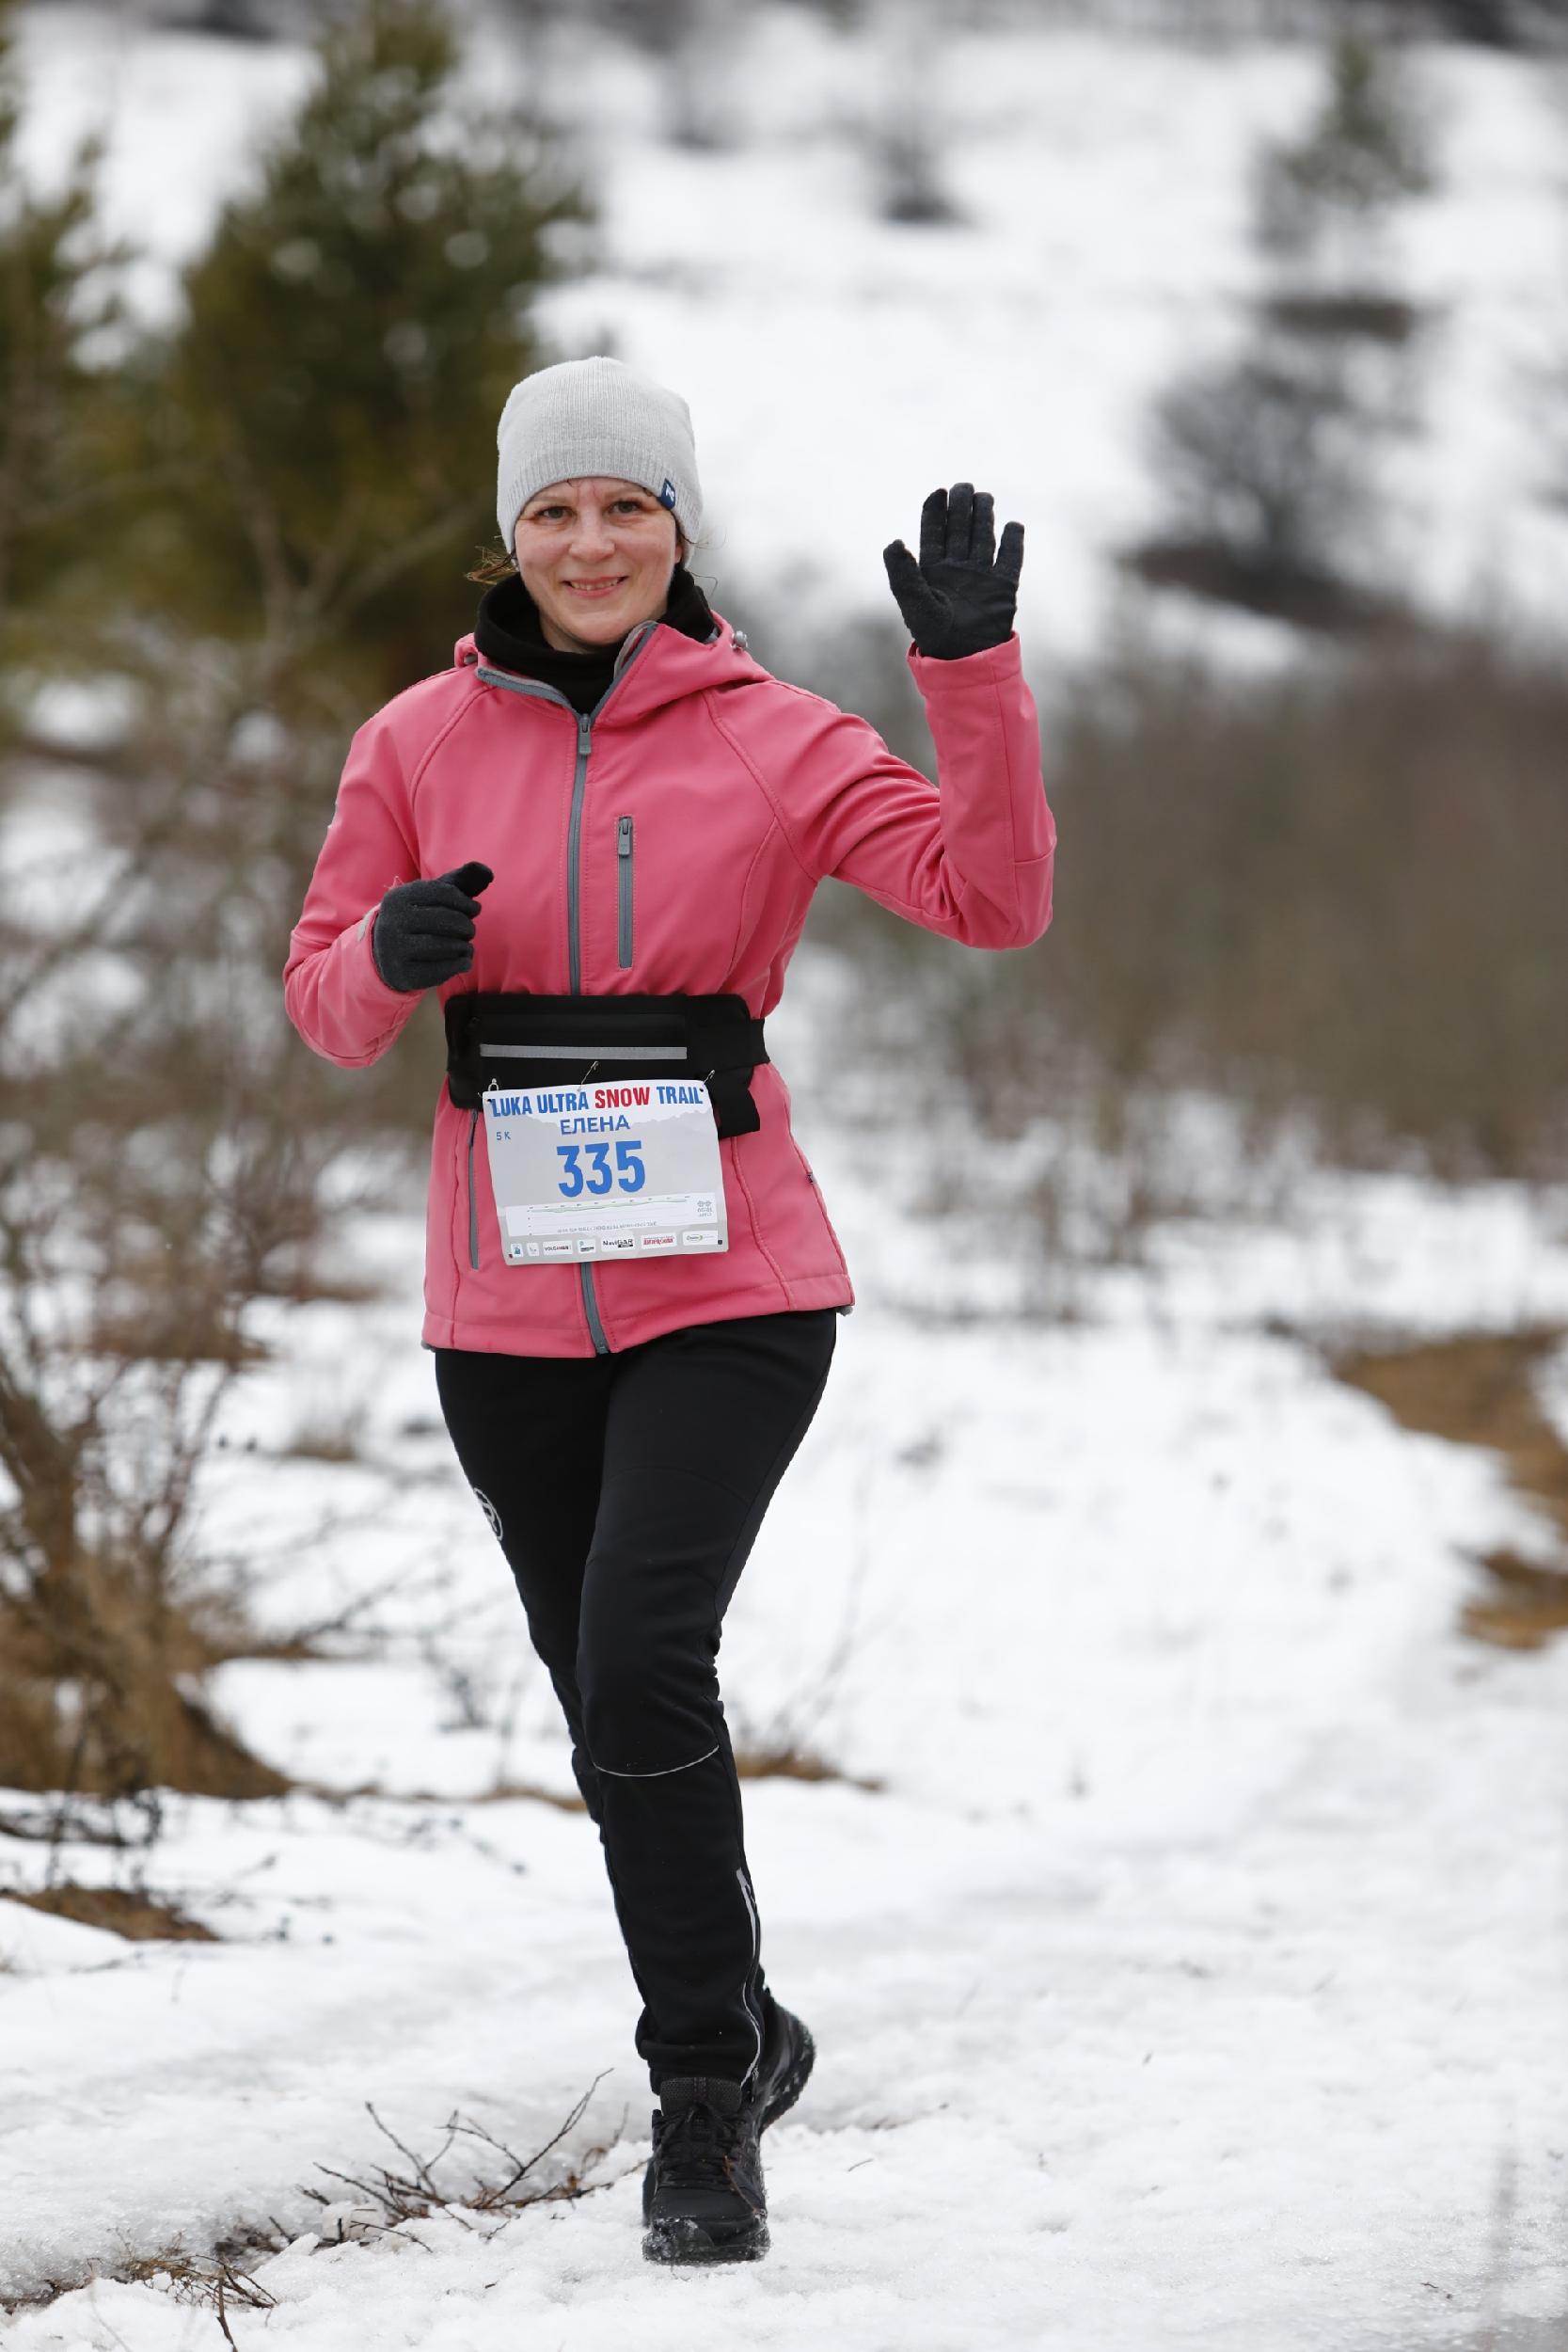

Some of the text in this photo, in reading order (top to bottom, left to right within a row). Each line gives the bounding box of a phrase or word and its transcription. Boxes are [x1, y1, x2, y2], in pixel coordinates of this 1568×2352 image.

[493, 1085, 704, 1118] LUKA ULTRA SNOW TRAIL
[496, 1131, 502, 1140] 5
[560, 1115, 630, 1136] ЕЛЕНА
[556, 1139, 646, 1198] 335
